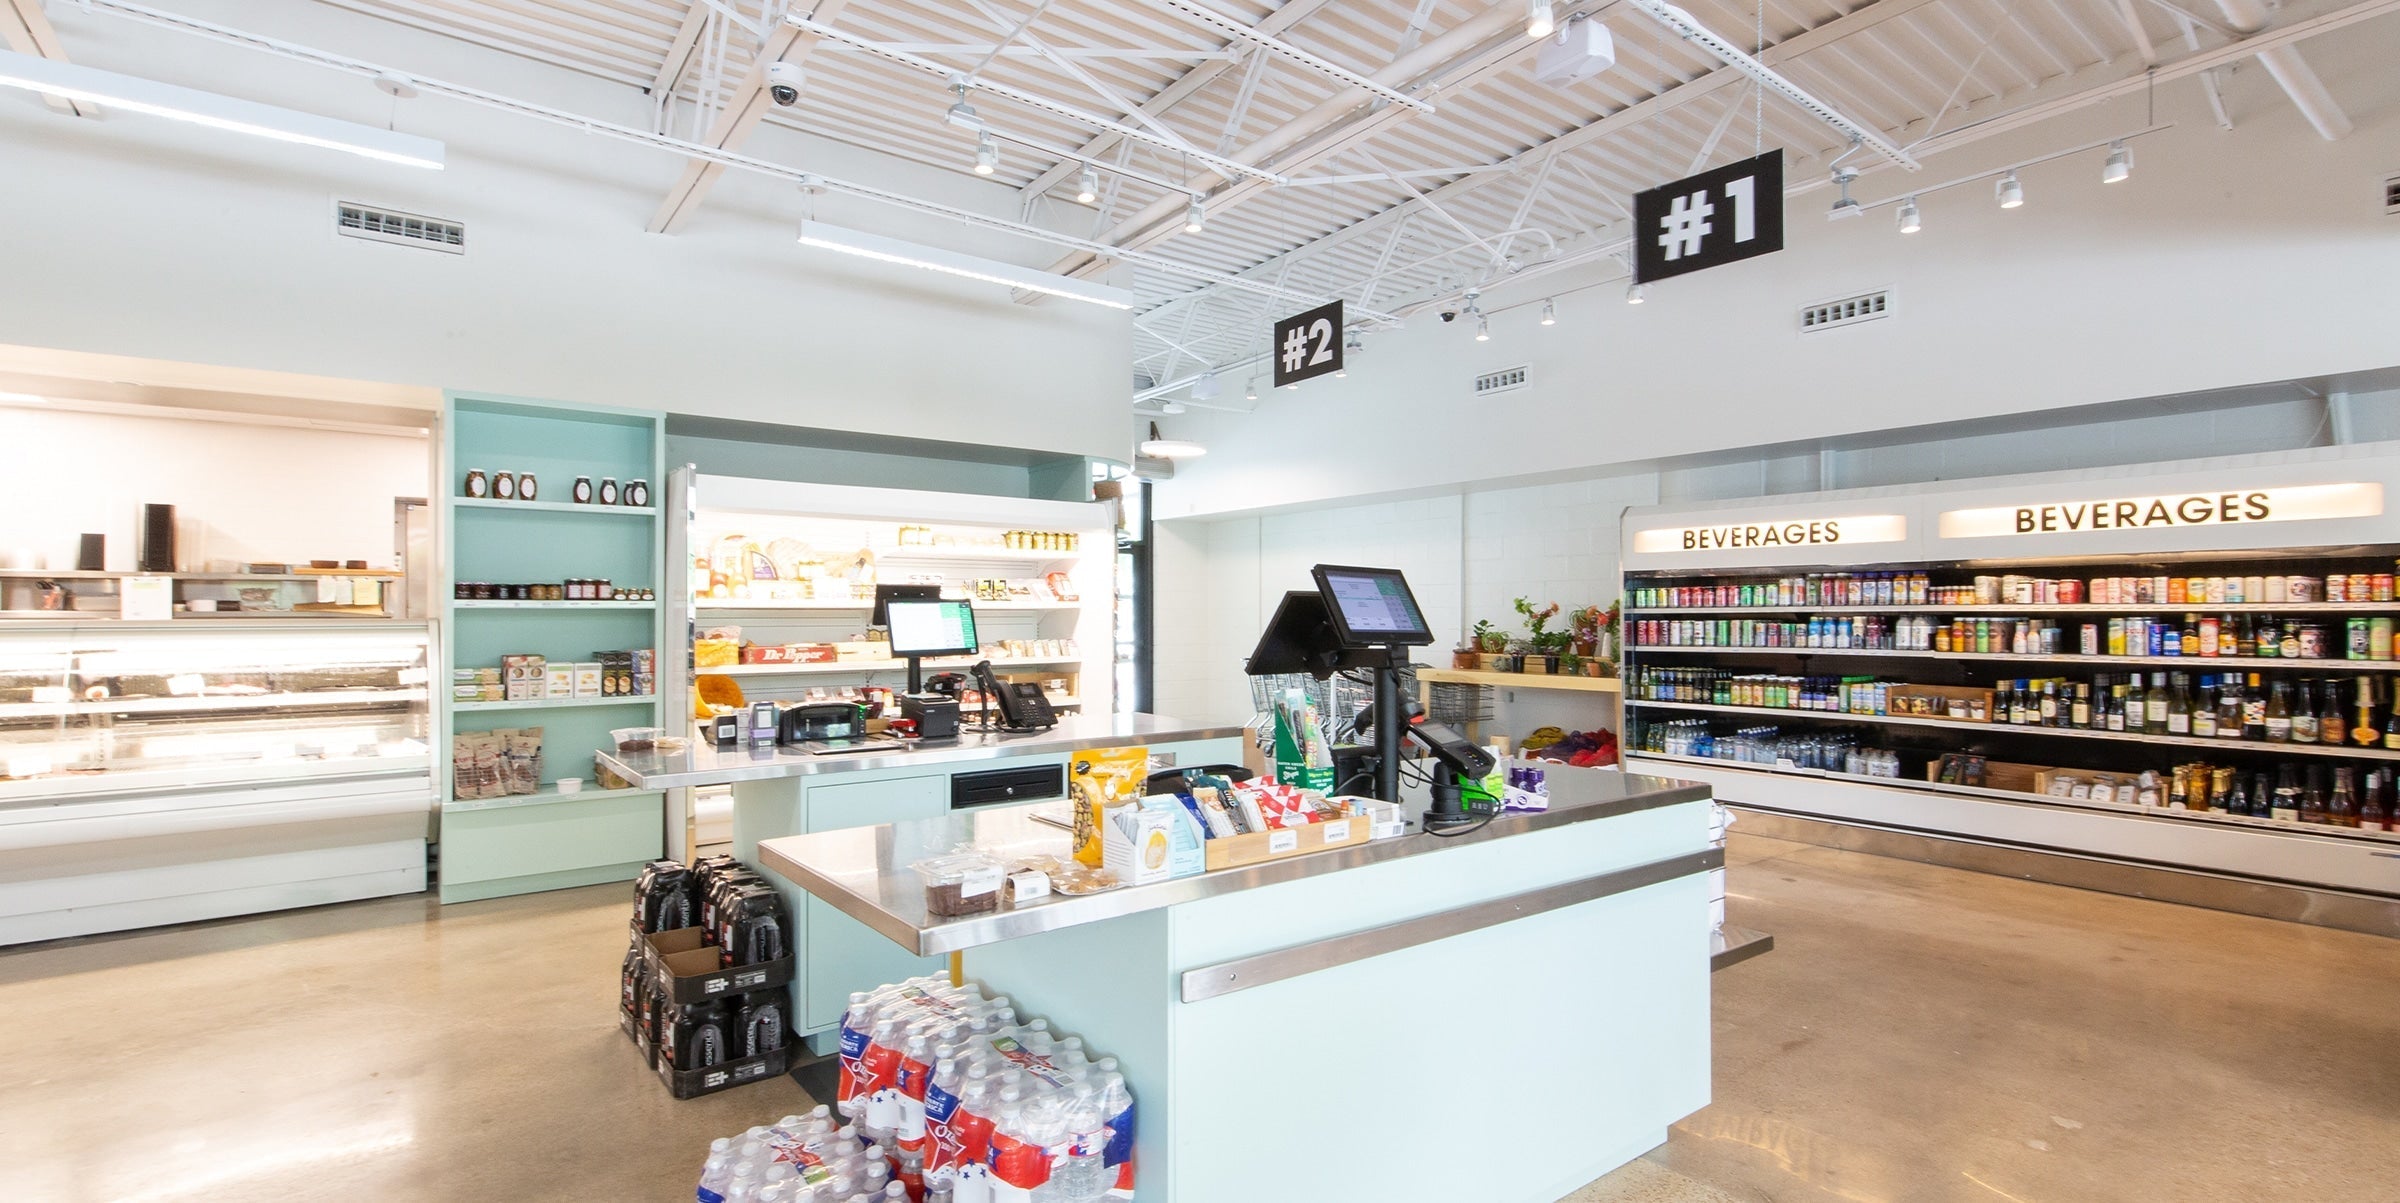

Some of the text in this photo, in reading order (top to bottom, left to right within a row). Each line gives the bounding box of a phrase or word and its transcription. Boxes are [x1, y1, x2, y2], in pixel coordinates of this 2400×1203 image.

[1658, 175, 1756, 262] #1
[1282, 317, 1334, 373] #2
[2015, 492, 2271, 533] BEVERAGES
[1682, 520, 1840, 550] BEVERAGES
[763, 649, 784, 661] Dr
[704, 1028, 713, 1067] essentia
